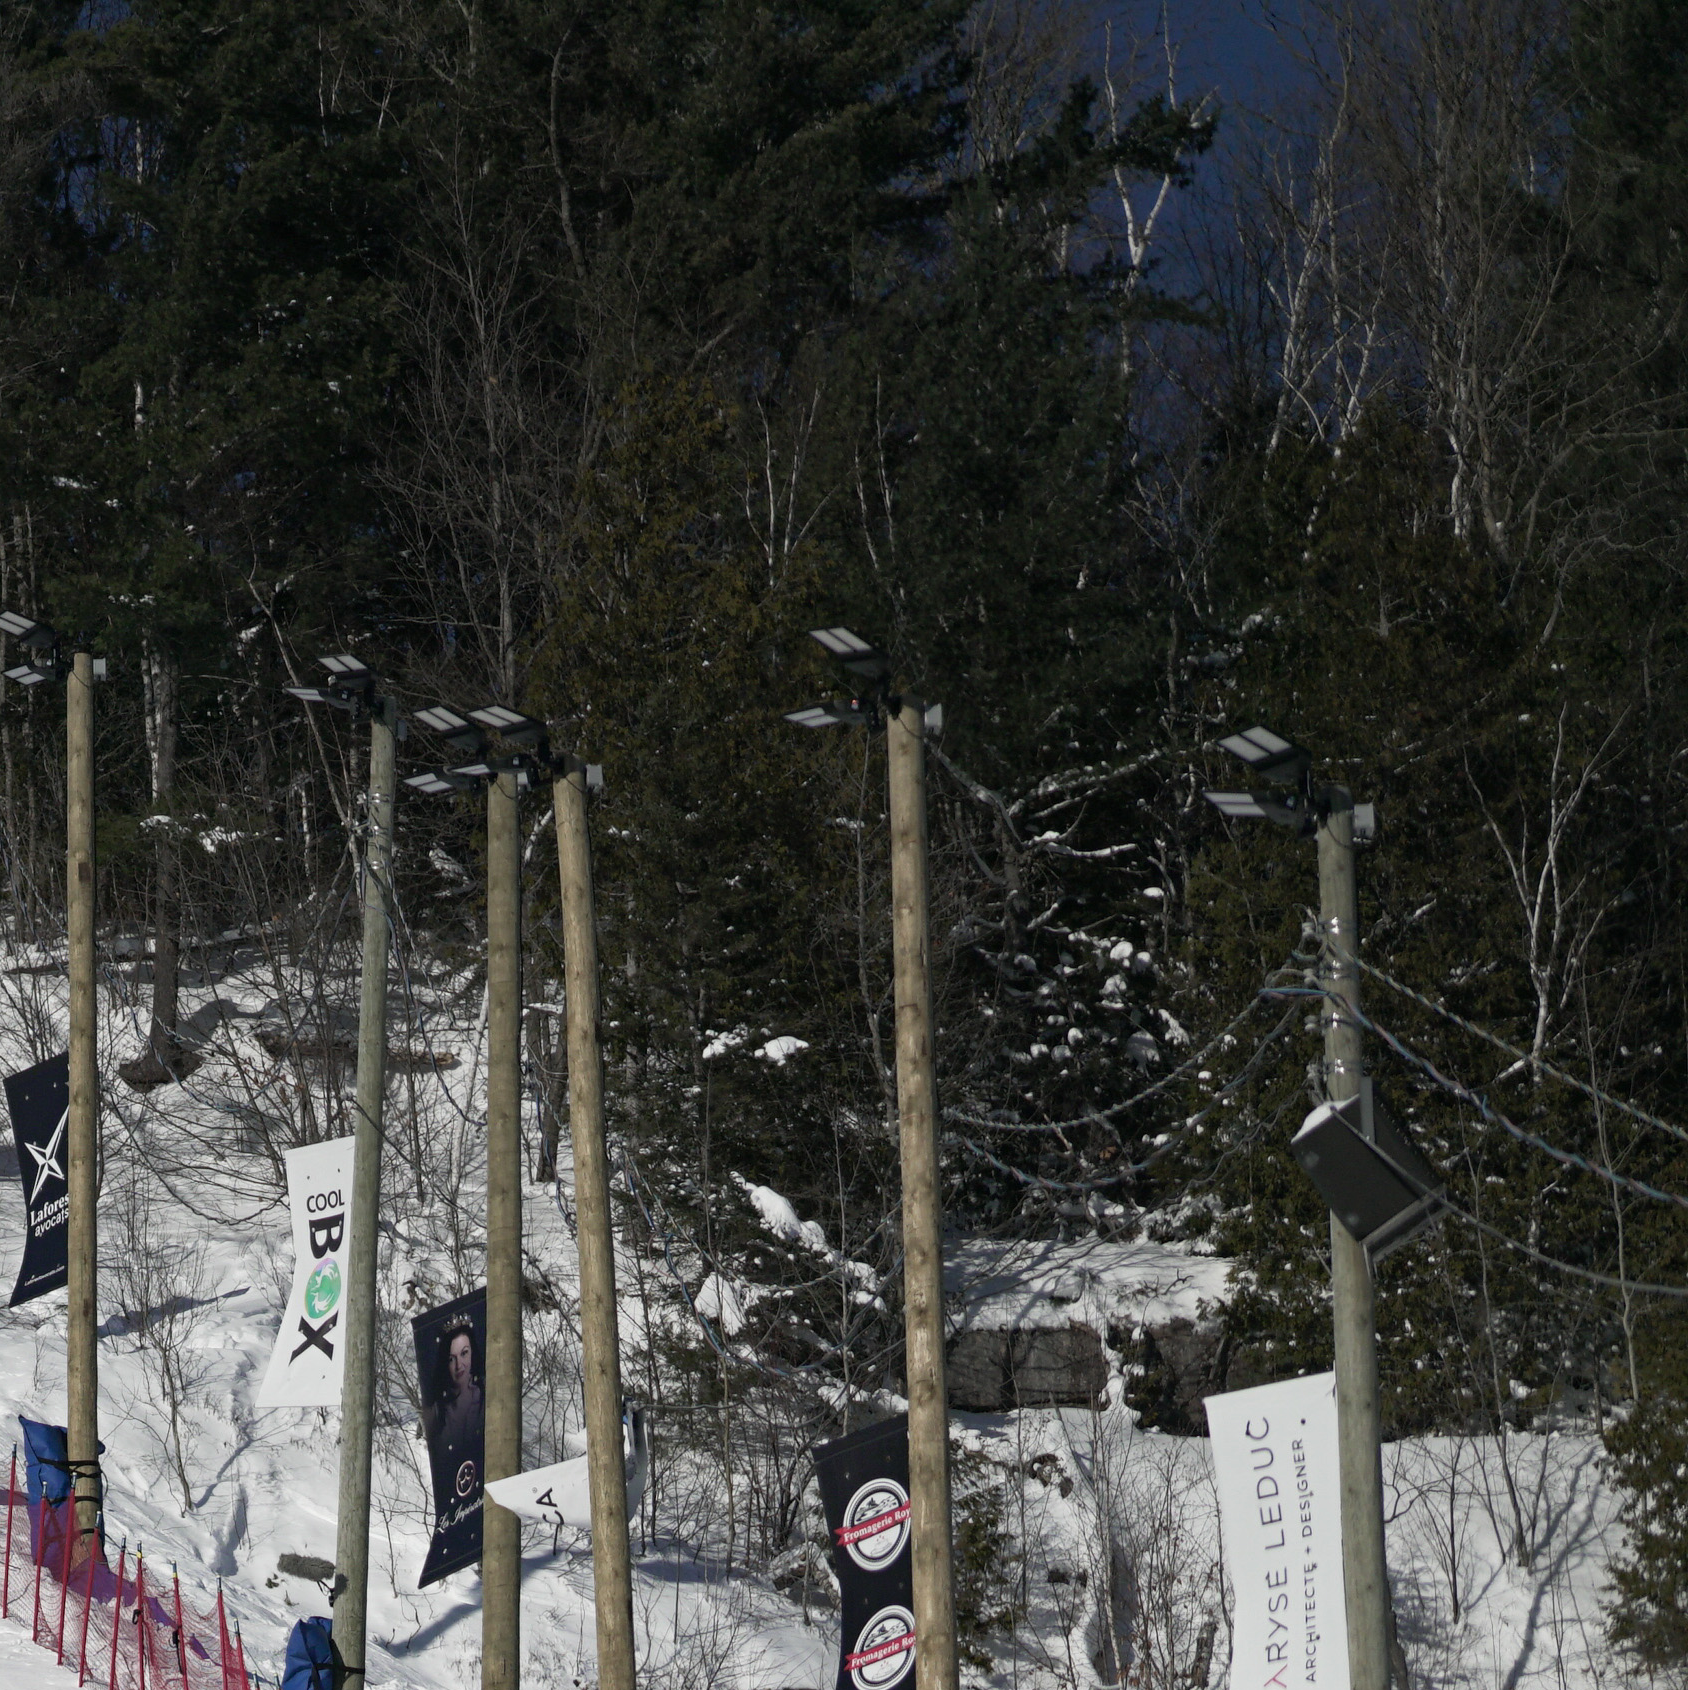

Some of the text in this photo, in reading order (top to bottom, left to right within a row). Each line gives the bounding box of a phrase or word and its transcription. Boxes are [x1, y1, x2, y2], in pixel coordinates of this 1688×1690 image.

[306, 1189, 345, 1213] COOL
[34, 1207, 69, 1237] avocats
[1246, 1415, 1286, 1552] LEDUC
[1291, 1438, 1313, 1538] DESIGNER
[843, 1514, 894, 1543] Fromagerie
[1304, 1564, 1317, 1683] ARCHITECTE
[851, 1640, 901, 1668] Fromagerie
